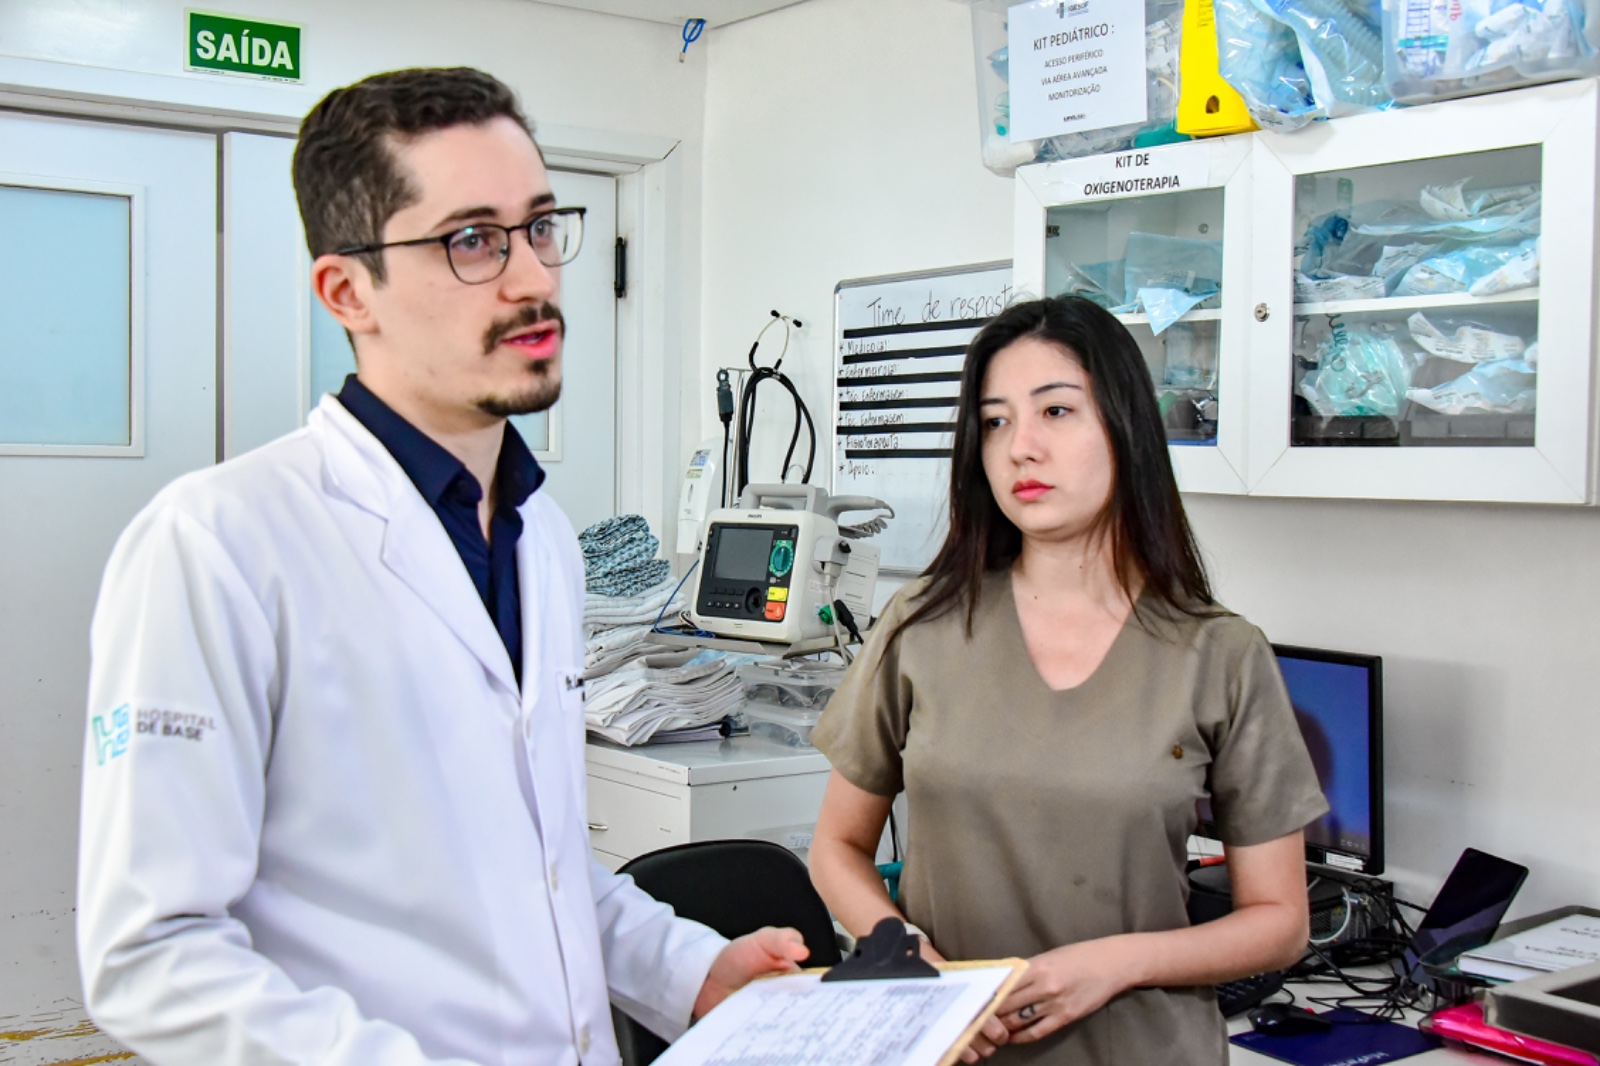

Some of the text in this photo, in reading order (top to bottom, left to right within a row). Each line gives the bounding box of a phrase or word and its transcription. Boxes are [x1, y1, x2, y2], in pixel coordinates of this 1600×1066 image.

[1033, 37, 1048, 51] KIT
[1050, 23, 1109, 47] PEDIÁTRICO
[196, 29, 294, 70] SAÍDA
[1044, 48, 1104, 69] ACESSO PERIFÉRICO
[1041, 66, 1108, 86] VIA AÉREA AVANÇADA
[1048, 84, 1101, 101] MONITORIZAÇÃO
[1115, 153, 1150, 168] KIT DE
[1084, 175, 1180, 195] OXIGENOTERAPIA
[867, 297, 906, 328] Time
[921, 290, 942, 323] de
[136, 708, 217, 730] HOSPITAL
[136, 721, 205, 742] DE BASE
